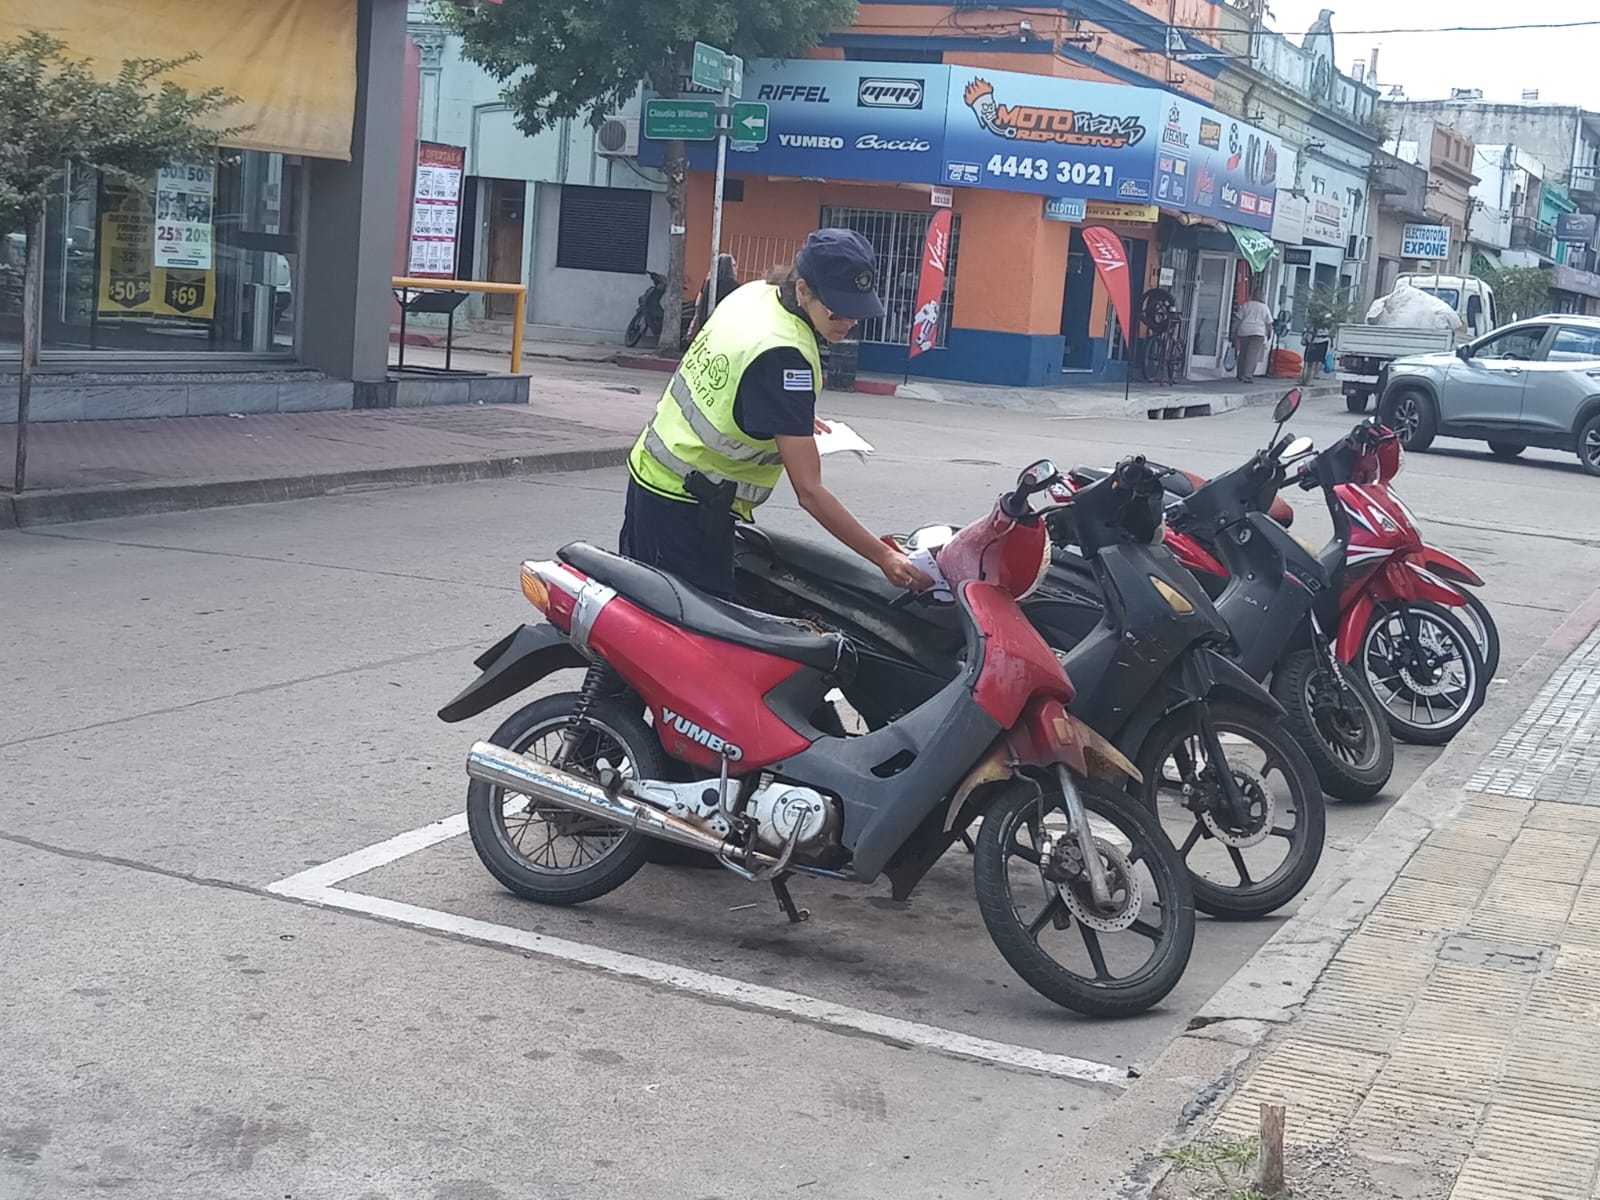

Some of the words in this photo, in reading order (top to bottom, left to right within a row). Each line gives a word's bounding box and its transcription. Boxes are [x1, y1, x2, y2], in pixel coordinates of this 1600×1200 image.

[758, 84, 830, 103] RIFFEL
[995, 103, 1074, 131] MOTO
[778, 134, 844, 149] YUMBO
[855, 134, 931, 152] Baccio
[1015, 129, 1128, 148] REPUESTOS
[425, 150, 456, 162] OFERTAS
[987, 154, 1048, 181] 4443
[1056, 161, 1114, 187] 3021
[1046, 200, 1081, 216] CREDITEL
[1405, 227, 1447, 242] ELECTROTOTAL
[1403, 241, 1446, 256] EXPONE
[172, 287, 197, 306] $69
[662, 706, 743, 761] YUMBO
